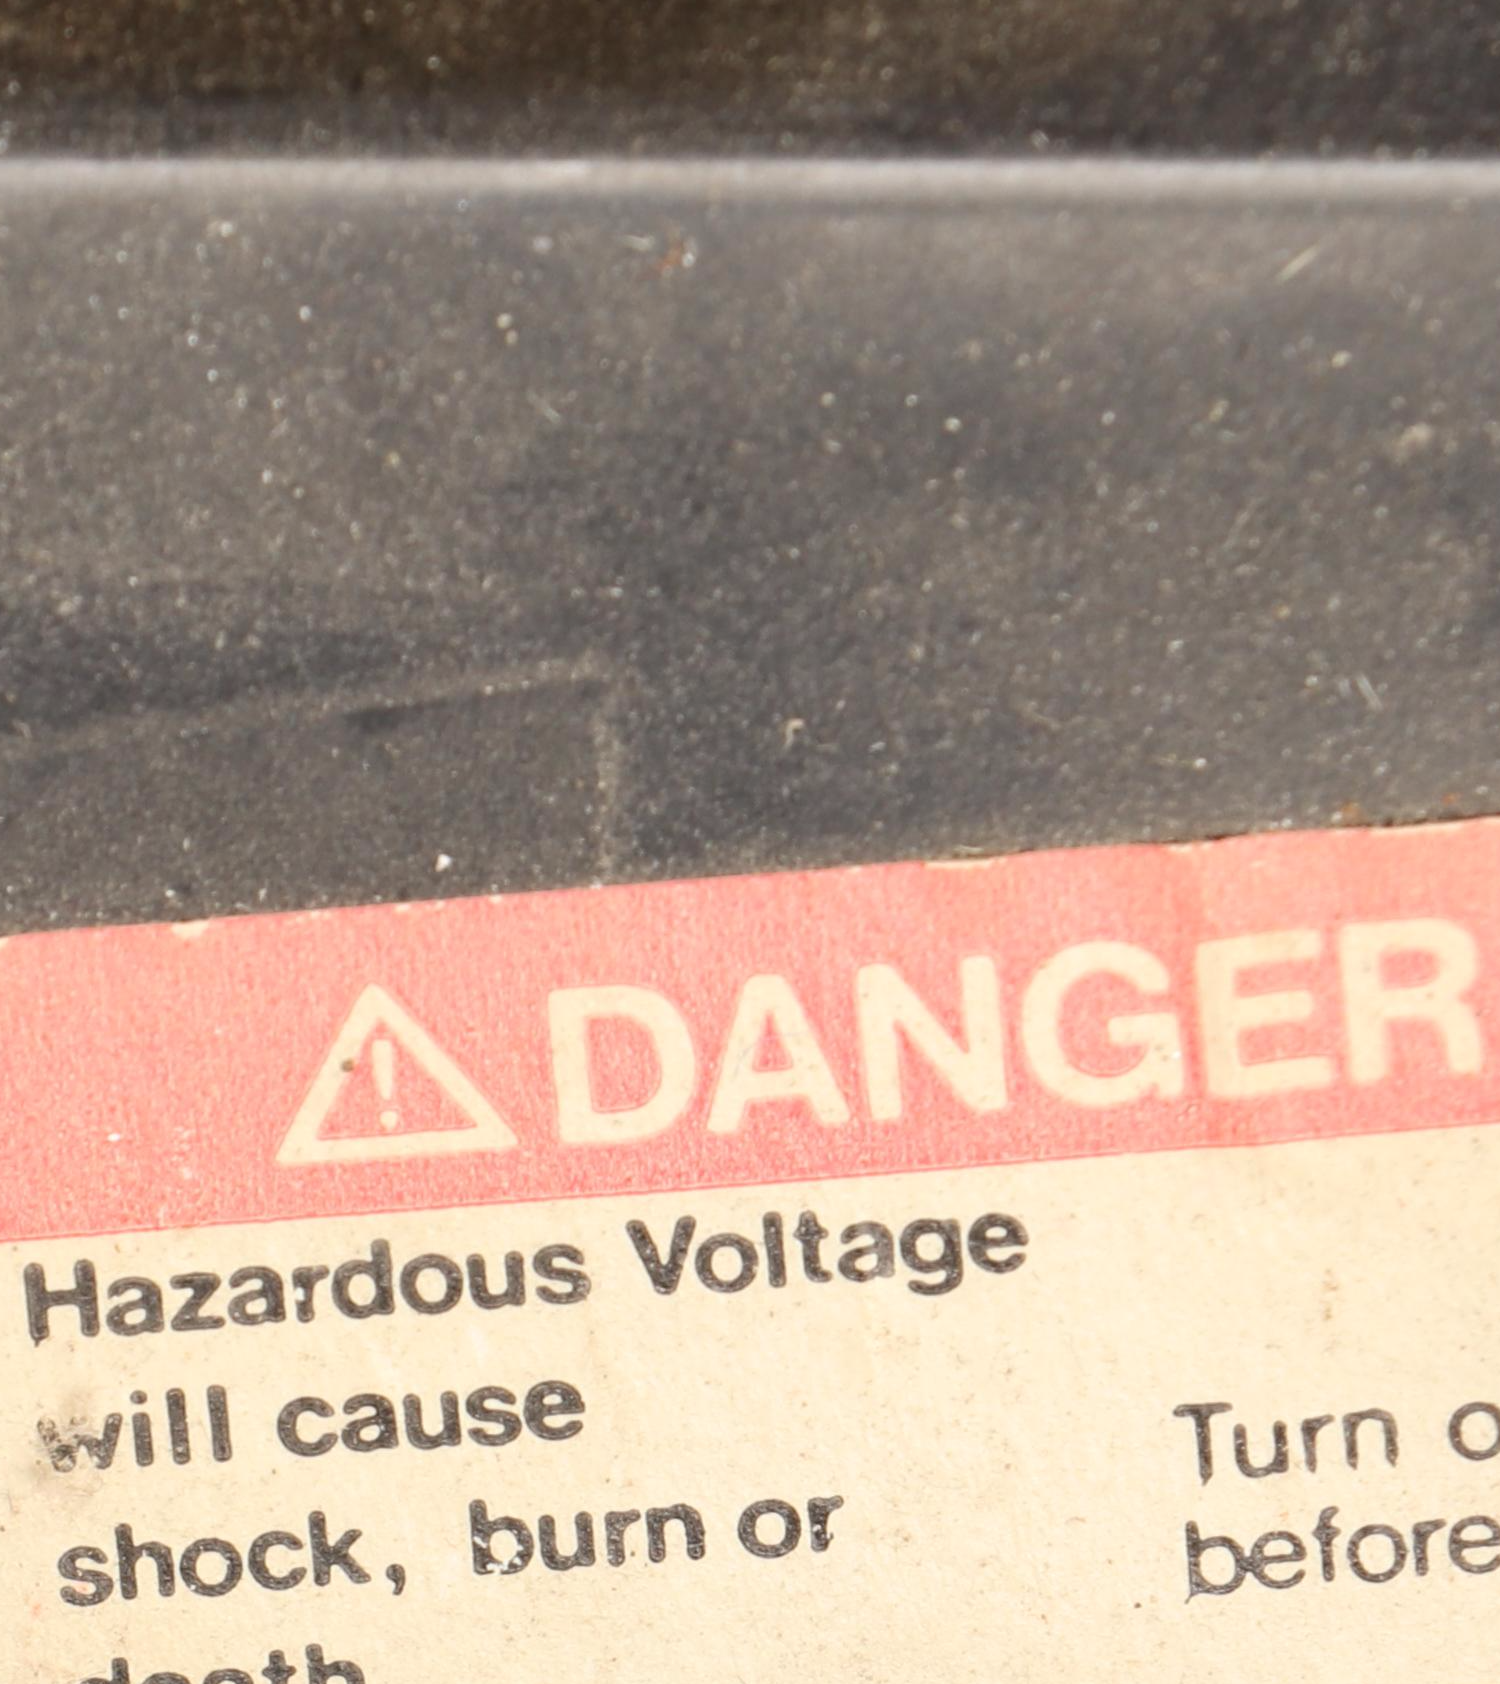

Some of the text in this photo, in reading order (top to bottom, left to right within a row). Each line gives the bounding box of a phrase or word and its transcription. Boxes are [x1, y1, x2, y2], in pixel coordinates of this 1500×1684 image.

[546, 916, 1485, 1147] DANGER
[22, 1210, 1031, 1344] Hazardous Voltage
[36, 1378, 587, 1473] will cause
[1173, 1401, 1400, 1486] Turn
[55, 1494, 845, 1608] shock, burn or
